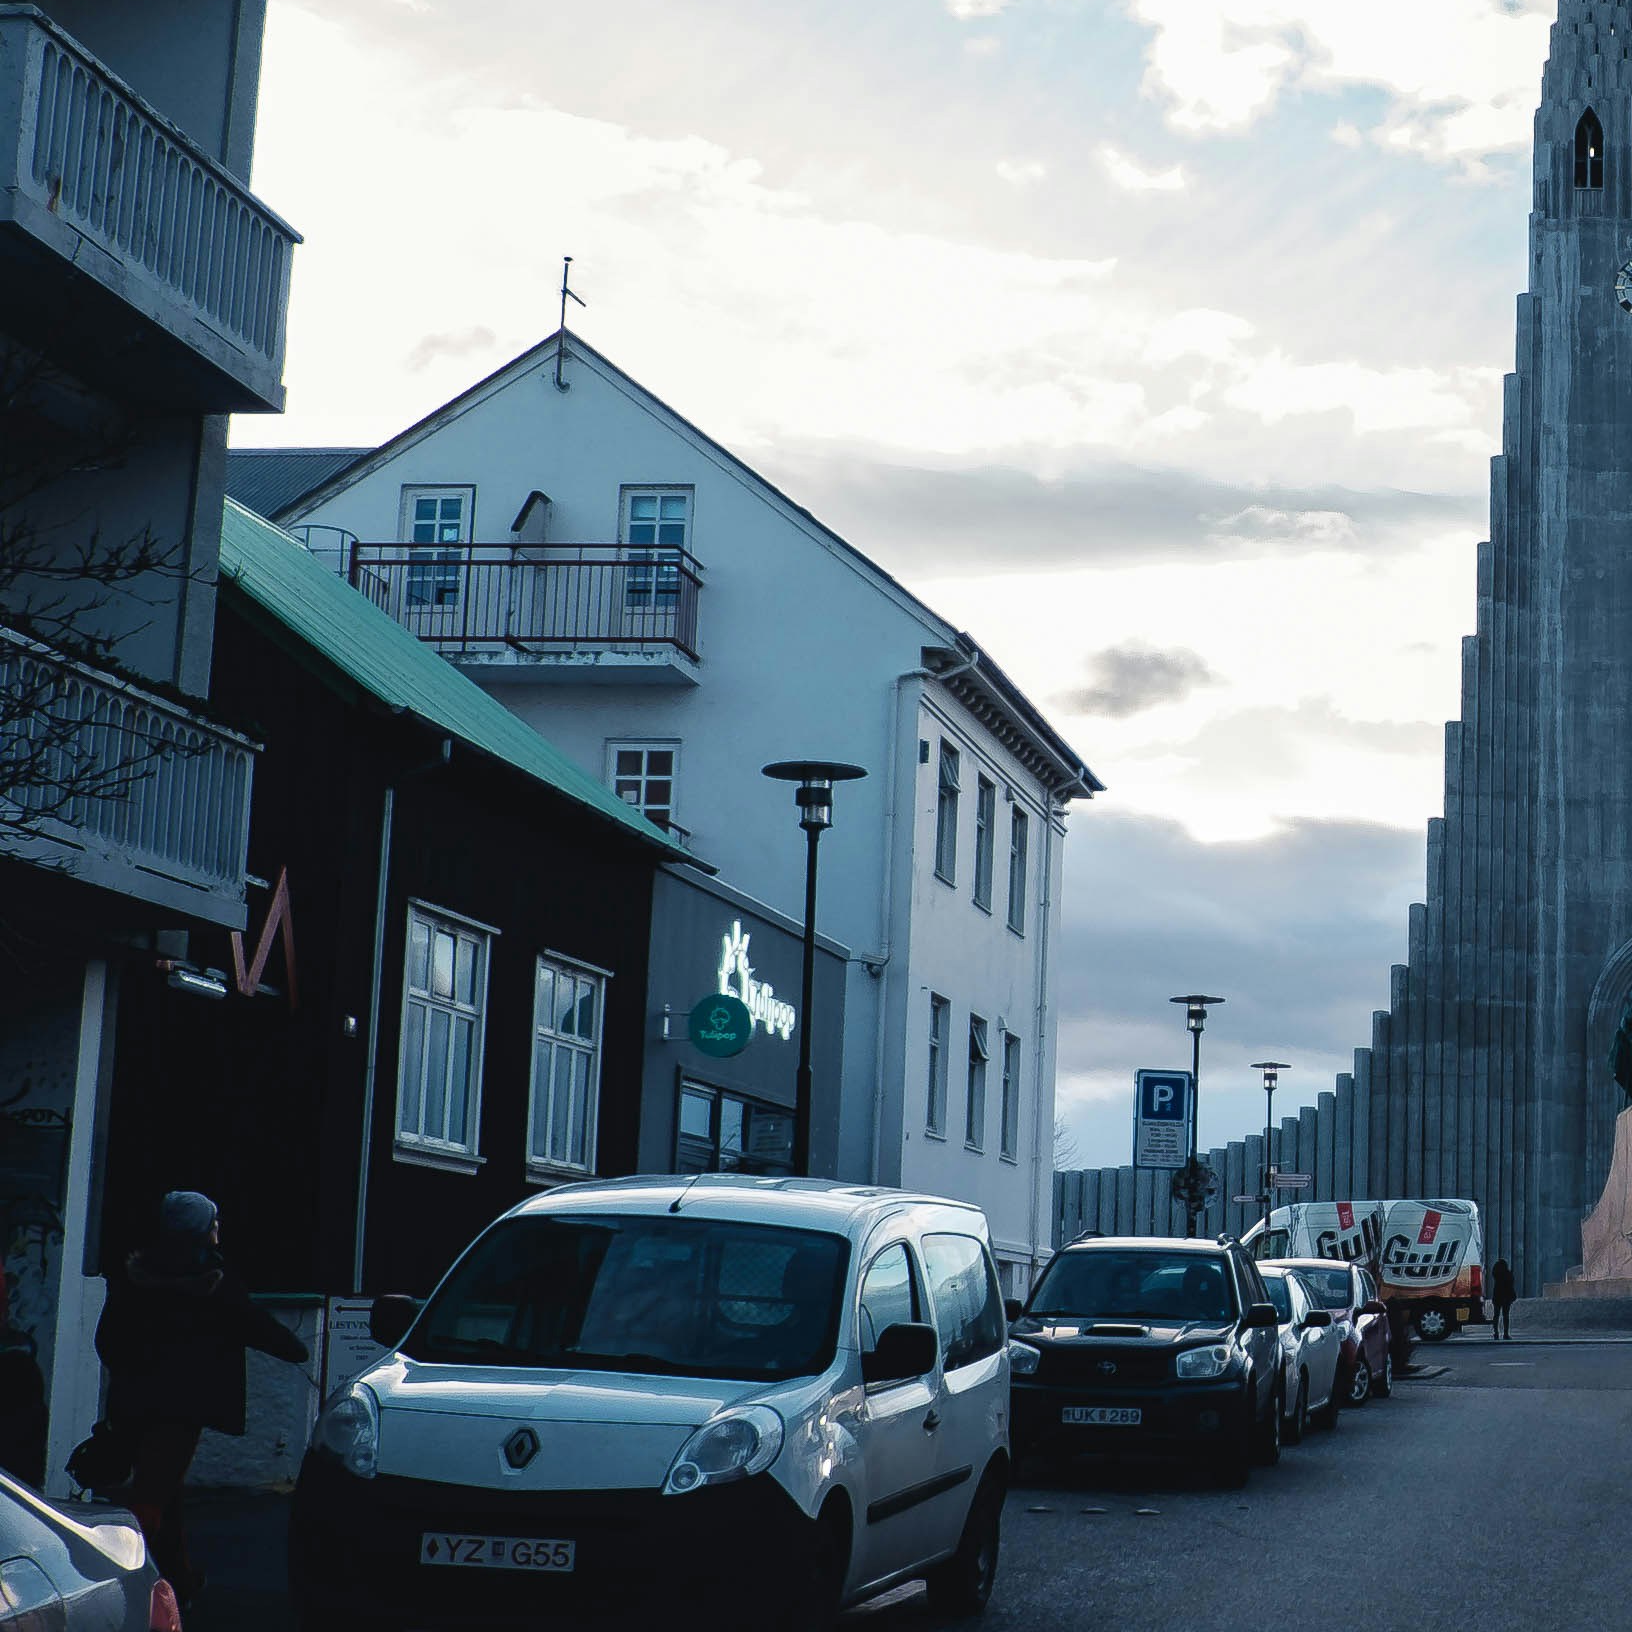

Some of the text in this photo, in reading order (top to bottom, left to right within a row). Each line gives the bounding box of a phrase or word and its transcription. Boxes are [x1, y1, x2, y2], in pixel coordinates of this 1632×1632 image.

[699, 1029, 737, 1041] Tulipop
[1153, 1084, 1174, 1111] P
[1316, 1210, 1382, 1265] Gull
[1382, 1233, 1462, 1280] Gull
[444, 1535, 571, 1568] YZ G55
